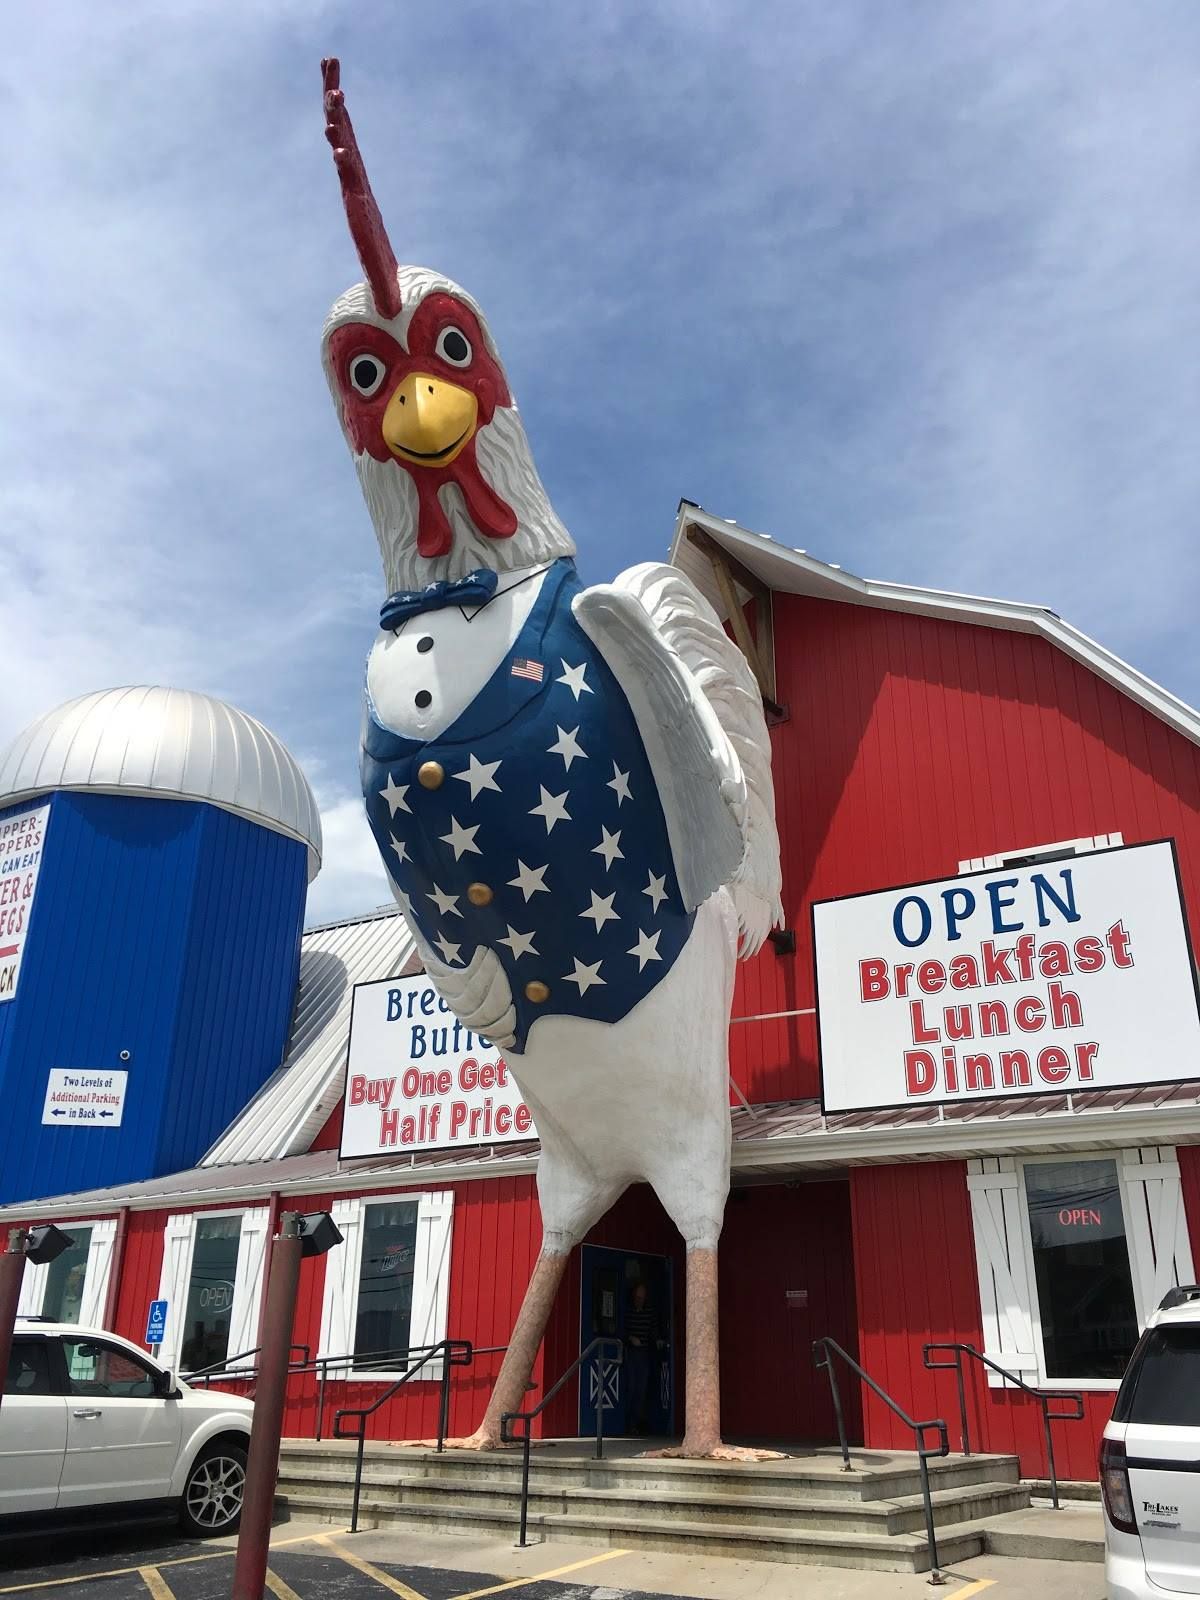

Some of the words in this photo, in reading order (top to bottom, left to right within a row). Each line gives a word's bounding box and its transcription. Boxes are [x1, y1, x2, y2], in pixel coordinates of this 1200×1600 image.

[0, 816, 42, 838] PPER-
[2, 856, 21, 874] CAN
[22, 851, 40, 868] EAT
[0, 876, 21, 906] ER
[892, 869, 1081, 948] OPEN
[858, 919, 1135, 1003] Breakfast
[909, 981, 1084, 1045] Lunch
[64, 1075, 79, 1087] Two
[81, 1076, 103, 1088] Levels
[104, 1077, 113, 1088] of
[903, 1041, 1099, 1097] Dinner
[349, 1074, 397, 1110] Buy
[402, 1066, 453, 1099] One
[458, 1056, 508, 1092] Get
[50, 1091, 90, 1104] Additional
[91, 1092, 120, 1105] Parking
[69, 1107, 76, 1118] in
[78, 1107, 96, 1119] Back
[379, 1103, 442, 1147] Half
[449, 1097, 532, 1140] Price
[1058, 1208, 1102, 1226] OPEN
[200, 1287, 232, 1307] OPEN
